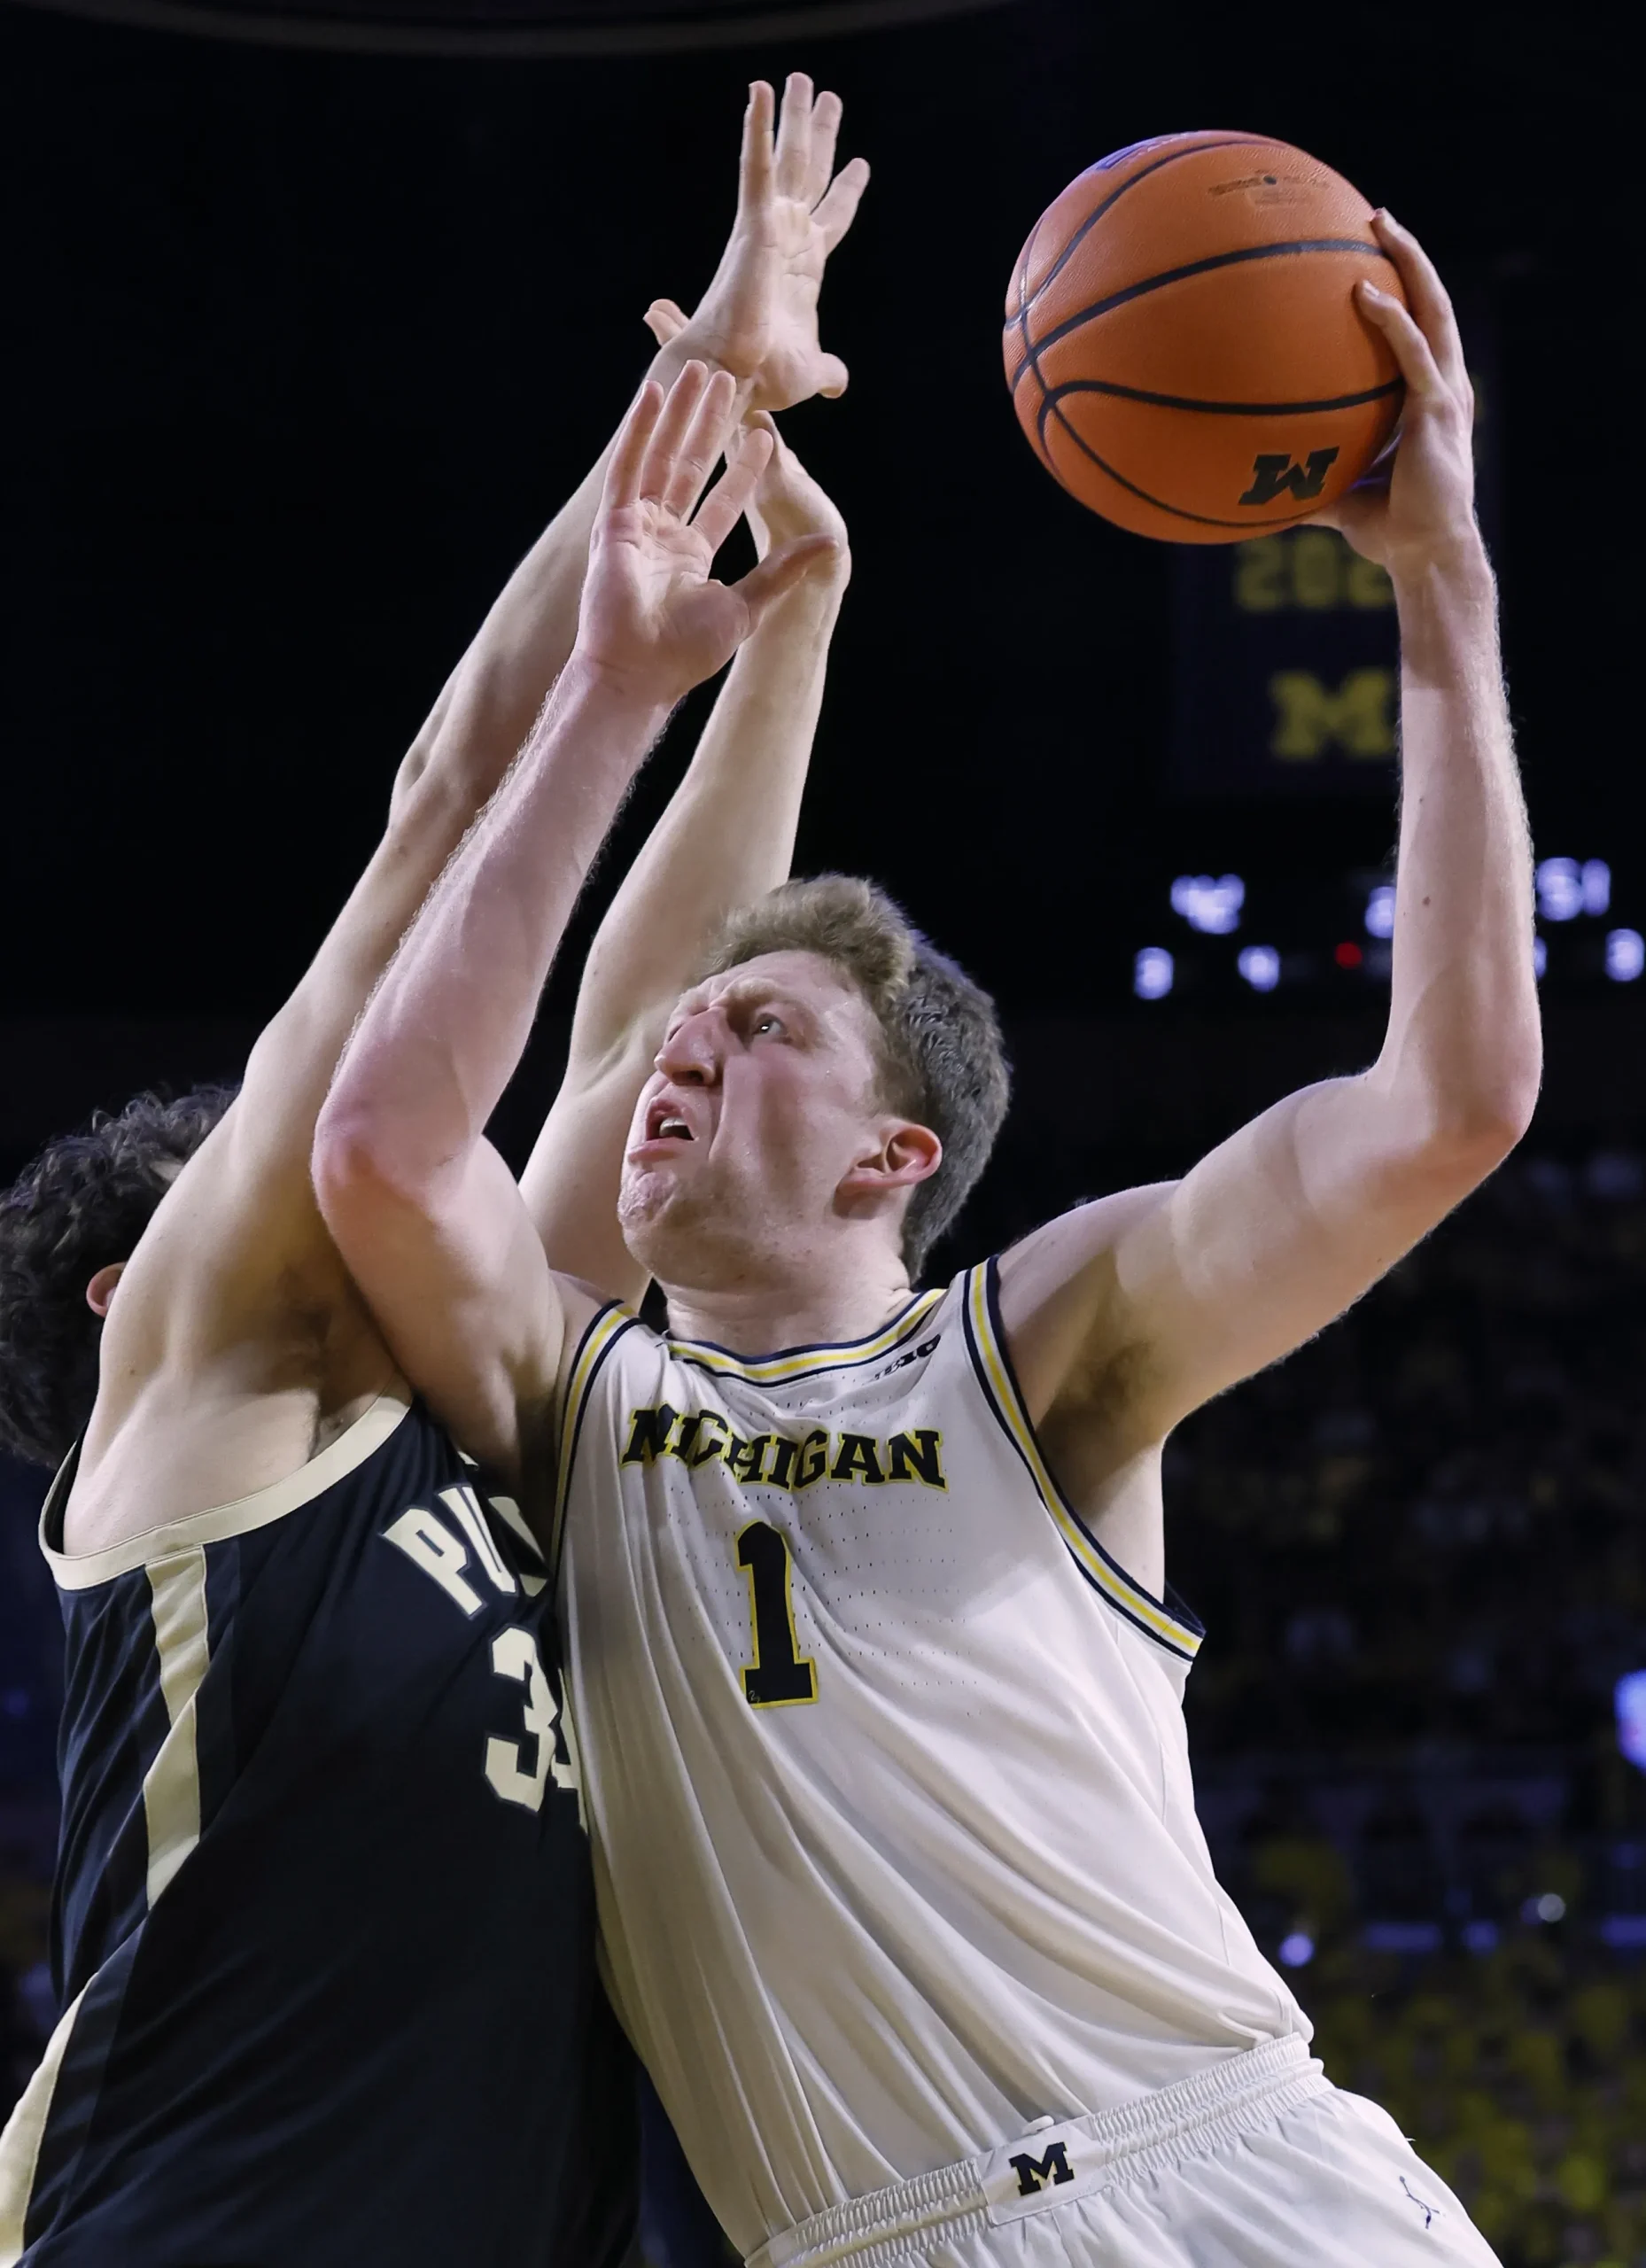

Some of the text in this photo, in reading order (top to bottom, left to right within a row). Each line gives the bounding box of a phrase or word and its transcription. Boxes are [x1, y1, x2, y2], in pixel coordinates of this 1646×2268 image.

[1269, 669, 1394, 761] M
[736, 1518, 819, 1709] 1
[1008, 2141, 1075, 2196] M
